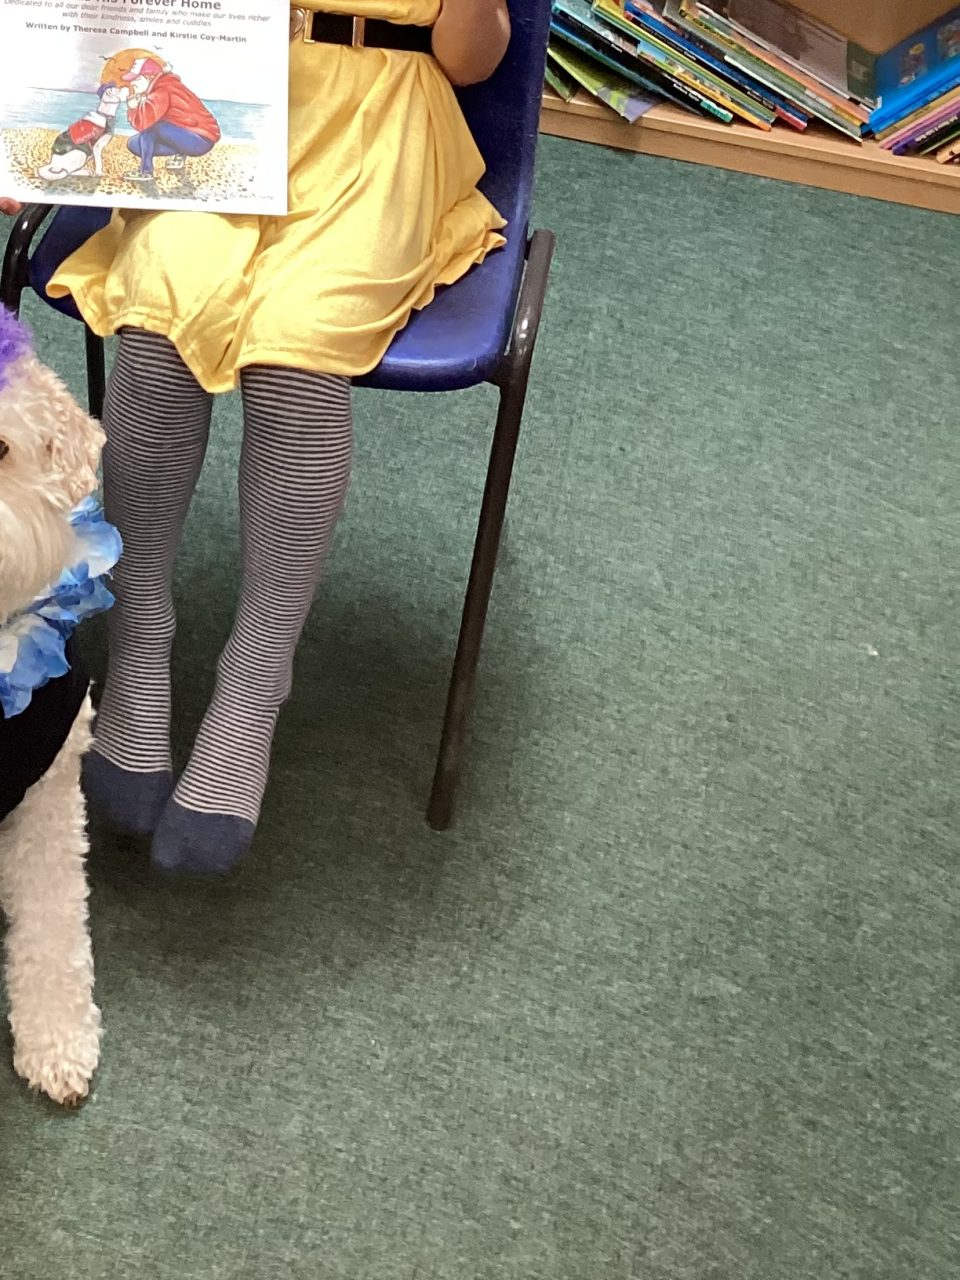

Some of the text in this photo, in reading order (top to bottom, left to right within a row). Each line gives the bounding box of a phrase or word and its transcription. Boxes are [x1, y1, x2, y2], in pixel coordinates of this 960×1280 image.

[101, 4, 127, 13] friends
[129, 6, 144, 14] and
[172, 9, 188, 17] who
[190, 10, 211, 18] make
[228, 12, 246, 20] lives
[248, 14, 271, 22] richer
[139, 16, 164, 24] smiles
[166, 17, 181, 25] and
[25, 21, 247, 43] Written by Theresa Campbell and Kirstie Coy-Martin
